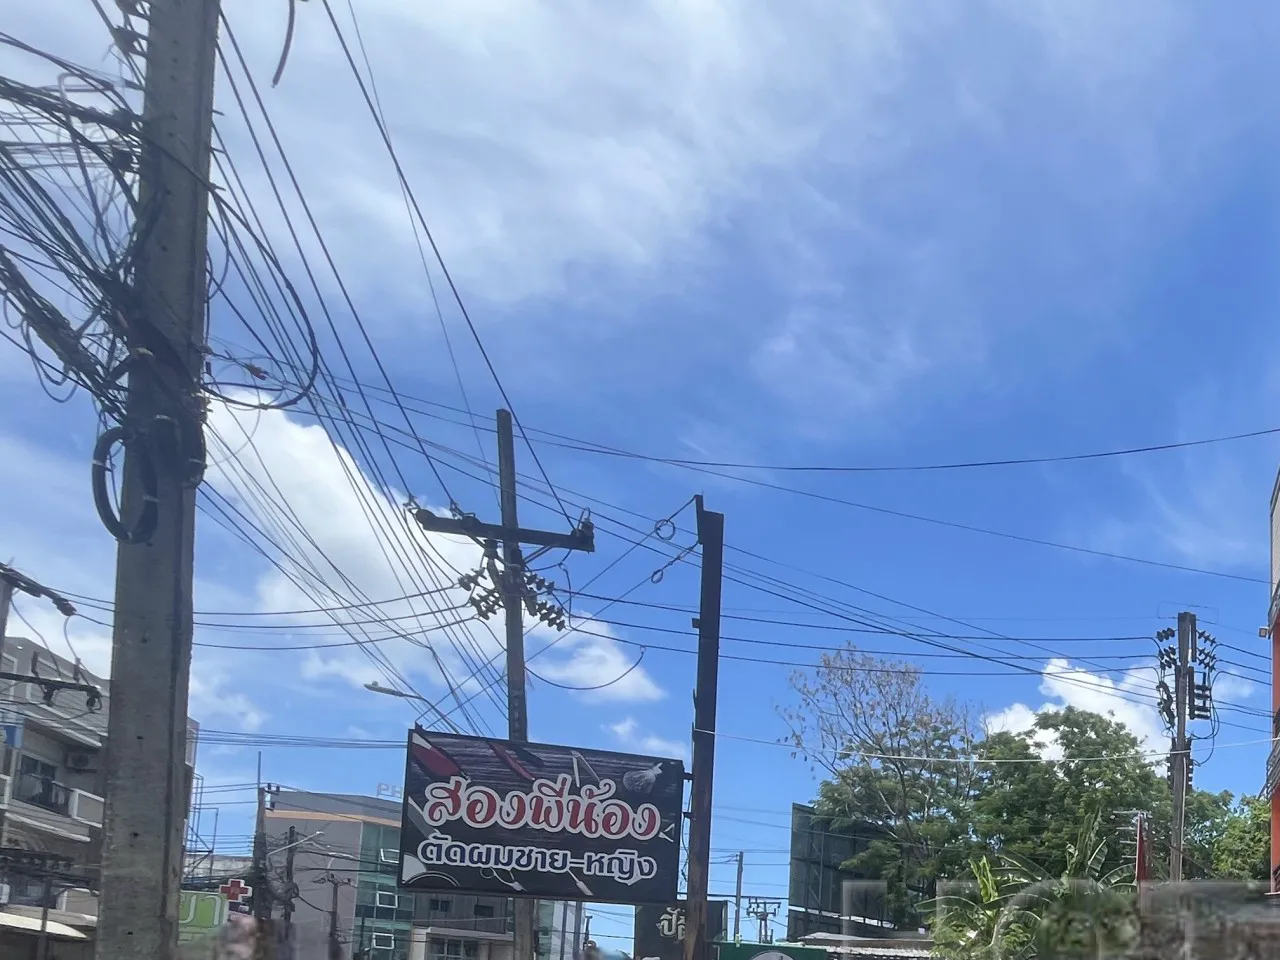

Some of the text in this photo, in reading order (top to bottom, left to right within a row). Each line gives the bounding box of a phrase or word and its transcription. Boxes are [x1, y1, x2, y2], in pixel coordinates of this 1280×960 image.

[423, 772, 662, 840] สองพี่น้อง
[417, 832, 658, 886] ตัดผมชาย-หญิง
